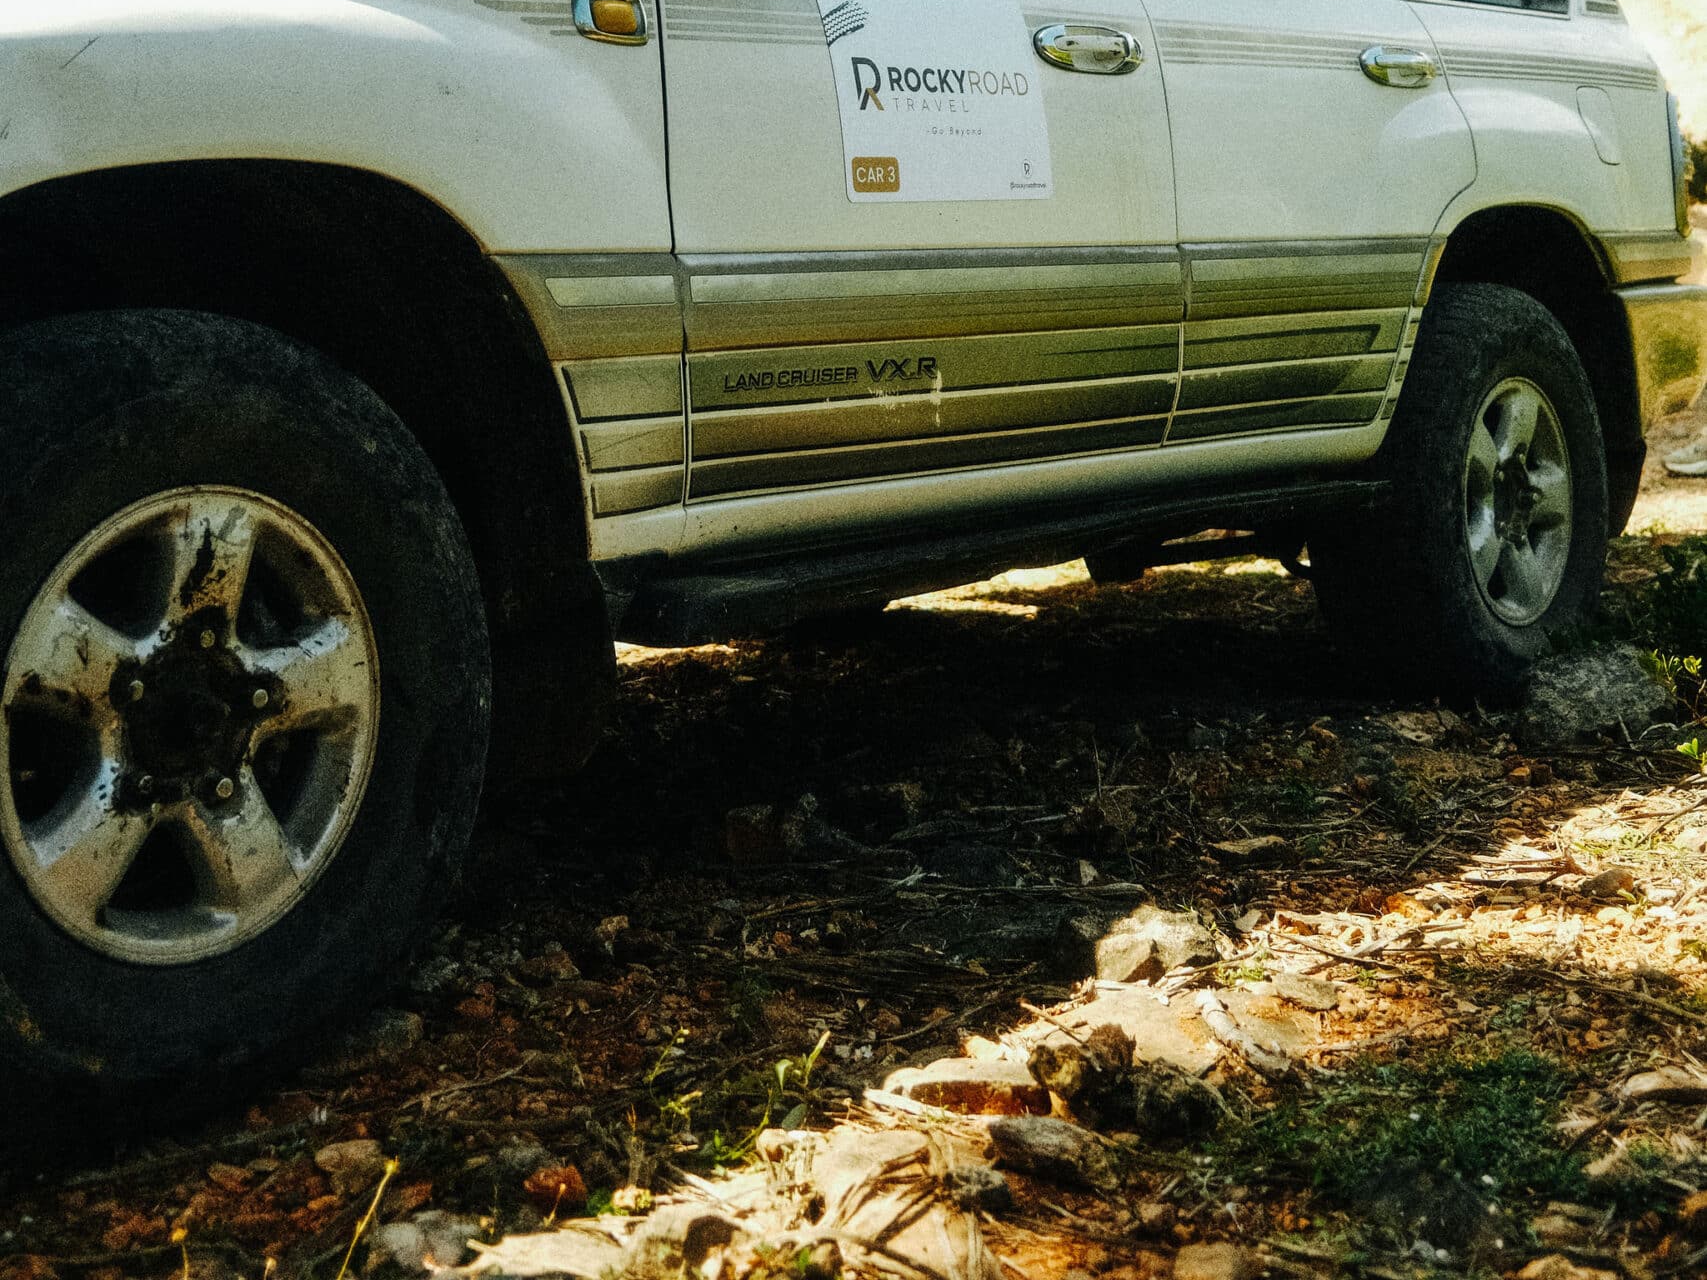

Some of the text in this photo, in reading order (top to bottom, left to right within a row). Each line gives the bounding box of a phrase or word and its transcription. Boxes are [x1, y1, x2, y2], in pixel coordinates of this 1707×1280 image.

[892, 97, 969, 113] TRAVEL
[856, 167, 896, 183] CAR 3
[723, 371, 774, 392] LAND
[776, 367, 858, 387] CRUISER
